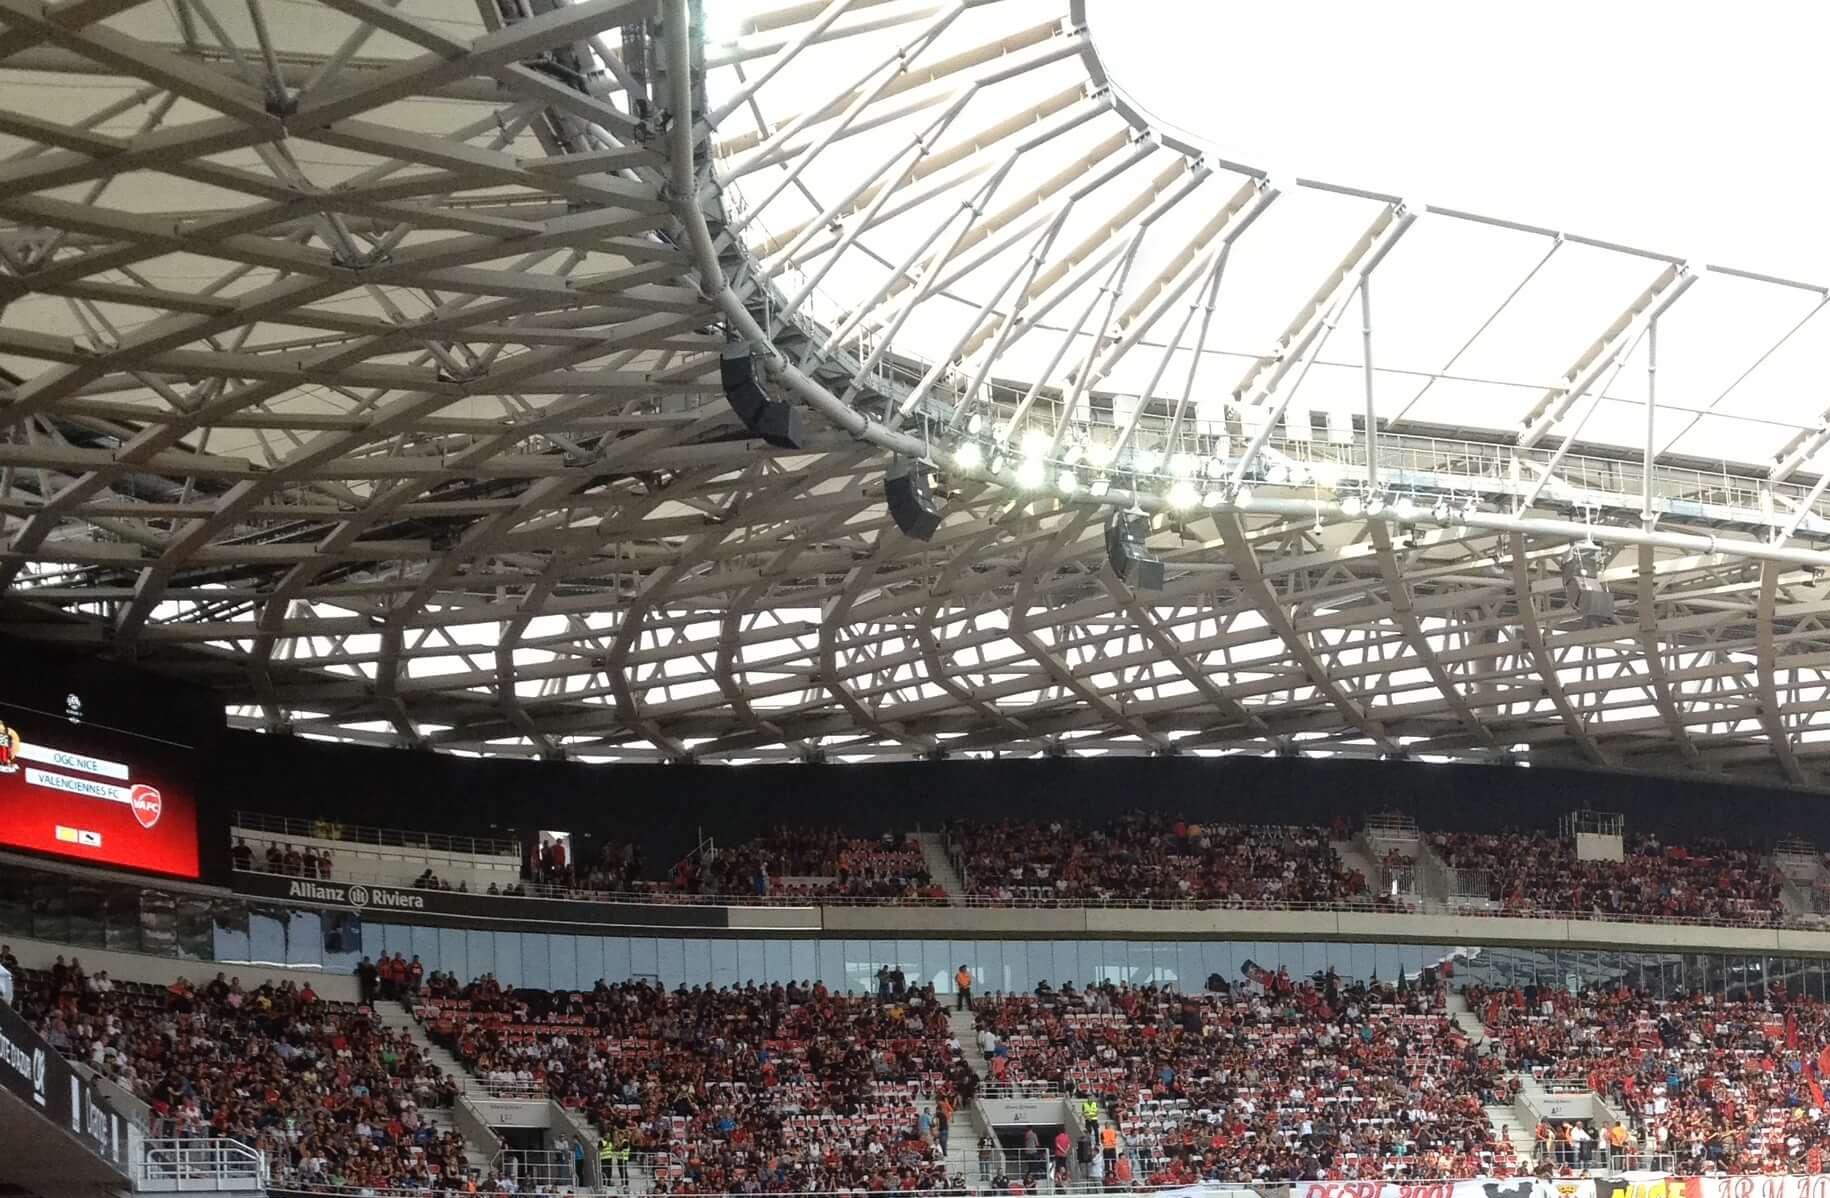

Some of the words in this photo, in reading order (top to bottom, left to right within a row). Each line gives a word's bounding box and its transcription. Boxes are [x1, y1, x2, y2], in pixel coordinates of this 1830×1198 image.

[53, 752, 76, 765] OGC
[77, 757, 99, 771] NICE
[38, 774, 107, 796] VALENCIENNES
[107, 788, 120, 799] FC
[289, 880, 345, 901] Allianz
[372, 889, 424, 908] Riviera
